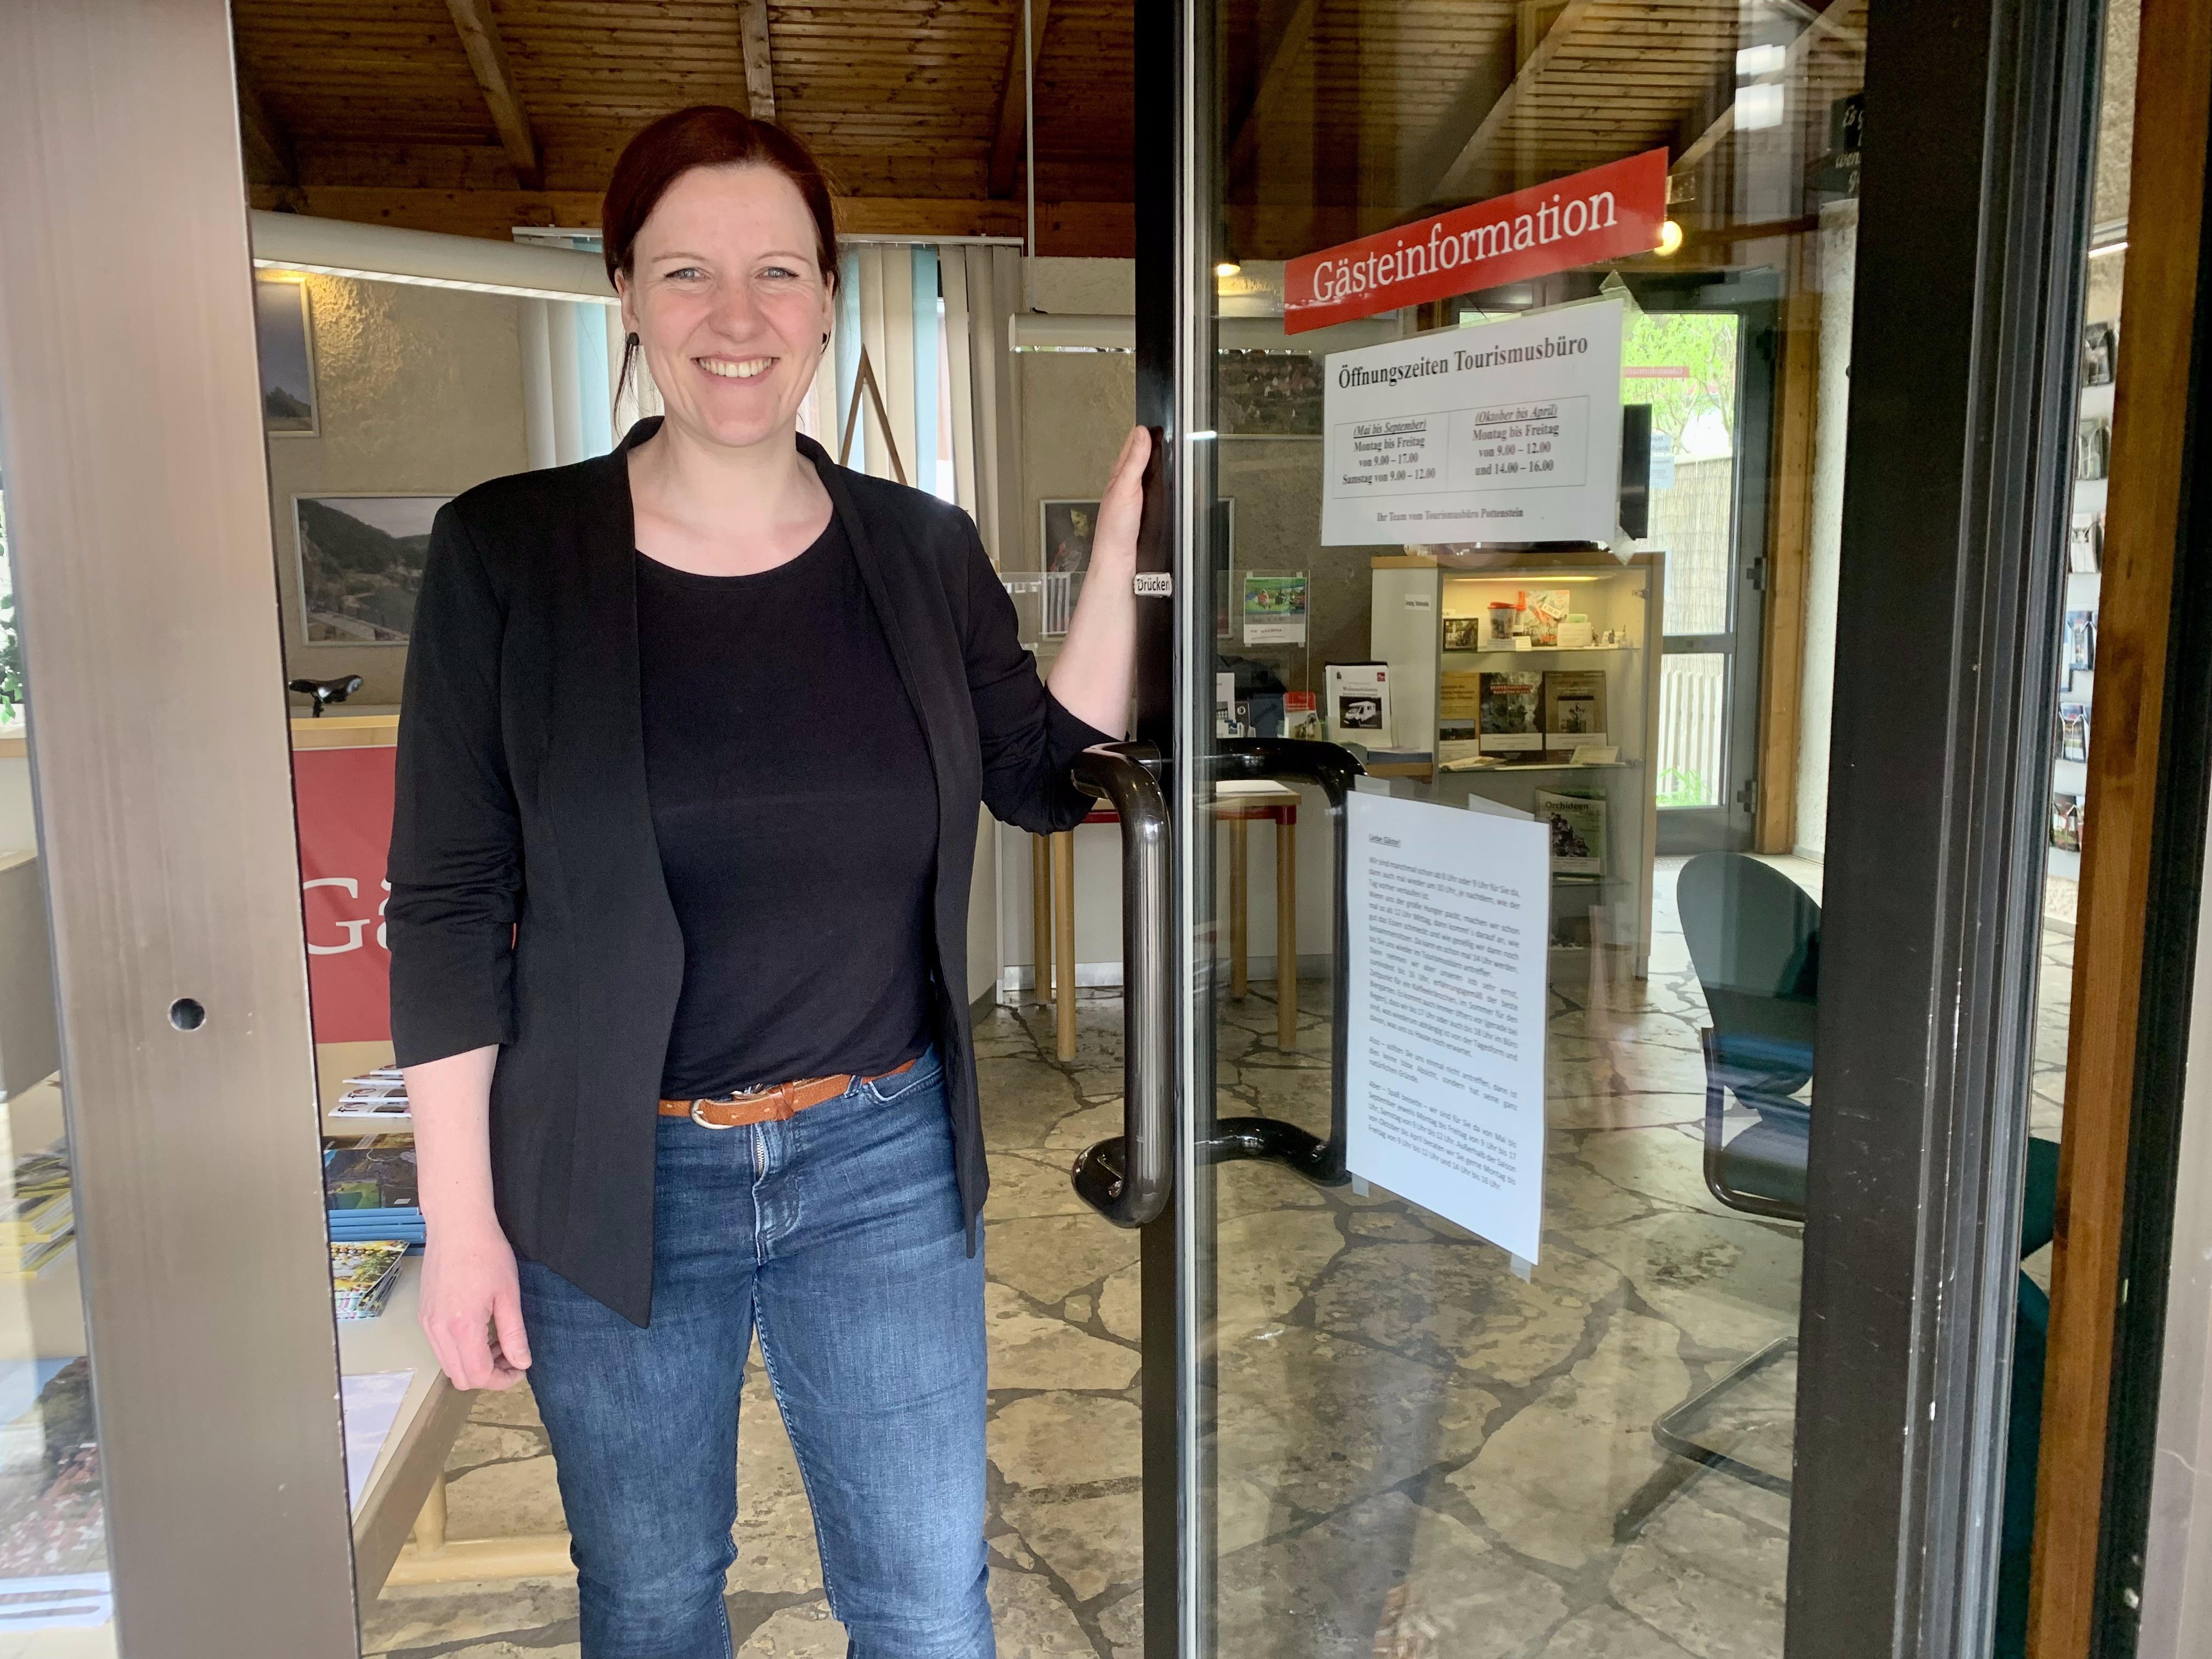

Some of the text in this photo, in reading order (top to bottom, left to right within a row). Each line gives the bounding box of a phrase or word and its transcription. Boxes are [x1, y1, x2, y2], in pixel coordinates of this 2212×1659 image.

[1313, 190, 1617, 302] Gästeinformation
[1339, 336, 1588, 388] Öffnungszeiten Tourismusbüro
[1475, 403, 1558, 426] (Oktober bis April)
[1353, 419, 1426, 437] (Mai bis September)
[1472, 424, 1559, 443] Montag bis Freitag
[1353, 436, 1425, 453] Montag bis Freitag
[1479, 448, 1494, 458] von
[1497, 445, 1515, 456] 9.00
[1526, 441, 1551, 455] 12.00
[1359, 458, 1372, 468] von
[1374, 455, 1389, 466] 9.00
[1398, 453, 1419, 464] 17.00
[1475, 464, 1492, 476] und
[1494, 462, 1518, 474] 14.00
[1529, 460, 1554, 472] 16.00
[1342, 474, 1373, 486] Samstag
[1374, 472, 1388, 482] von
[1390, 470, 1406, 481] 9.00
[1414, 468, 1436, 479] 12.00
[1377, 512, 1387, 522] Ihr
[1389, 512, 1407, 521] Team
[1426, 509, 1479, 521] Tourismusbüro
[1481, 508, 1523, 518] Pottenstein
[1137, 577, 1170, 591] Drücken
[1545, 801, 1589, 810] Orchideen
